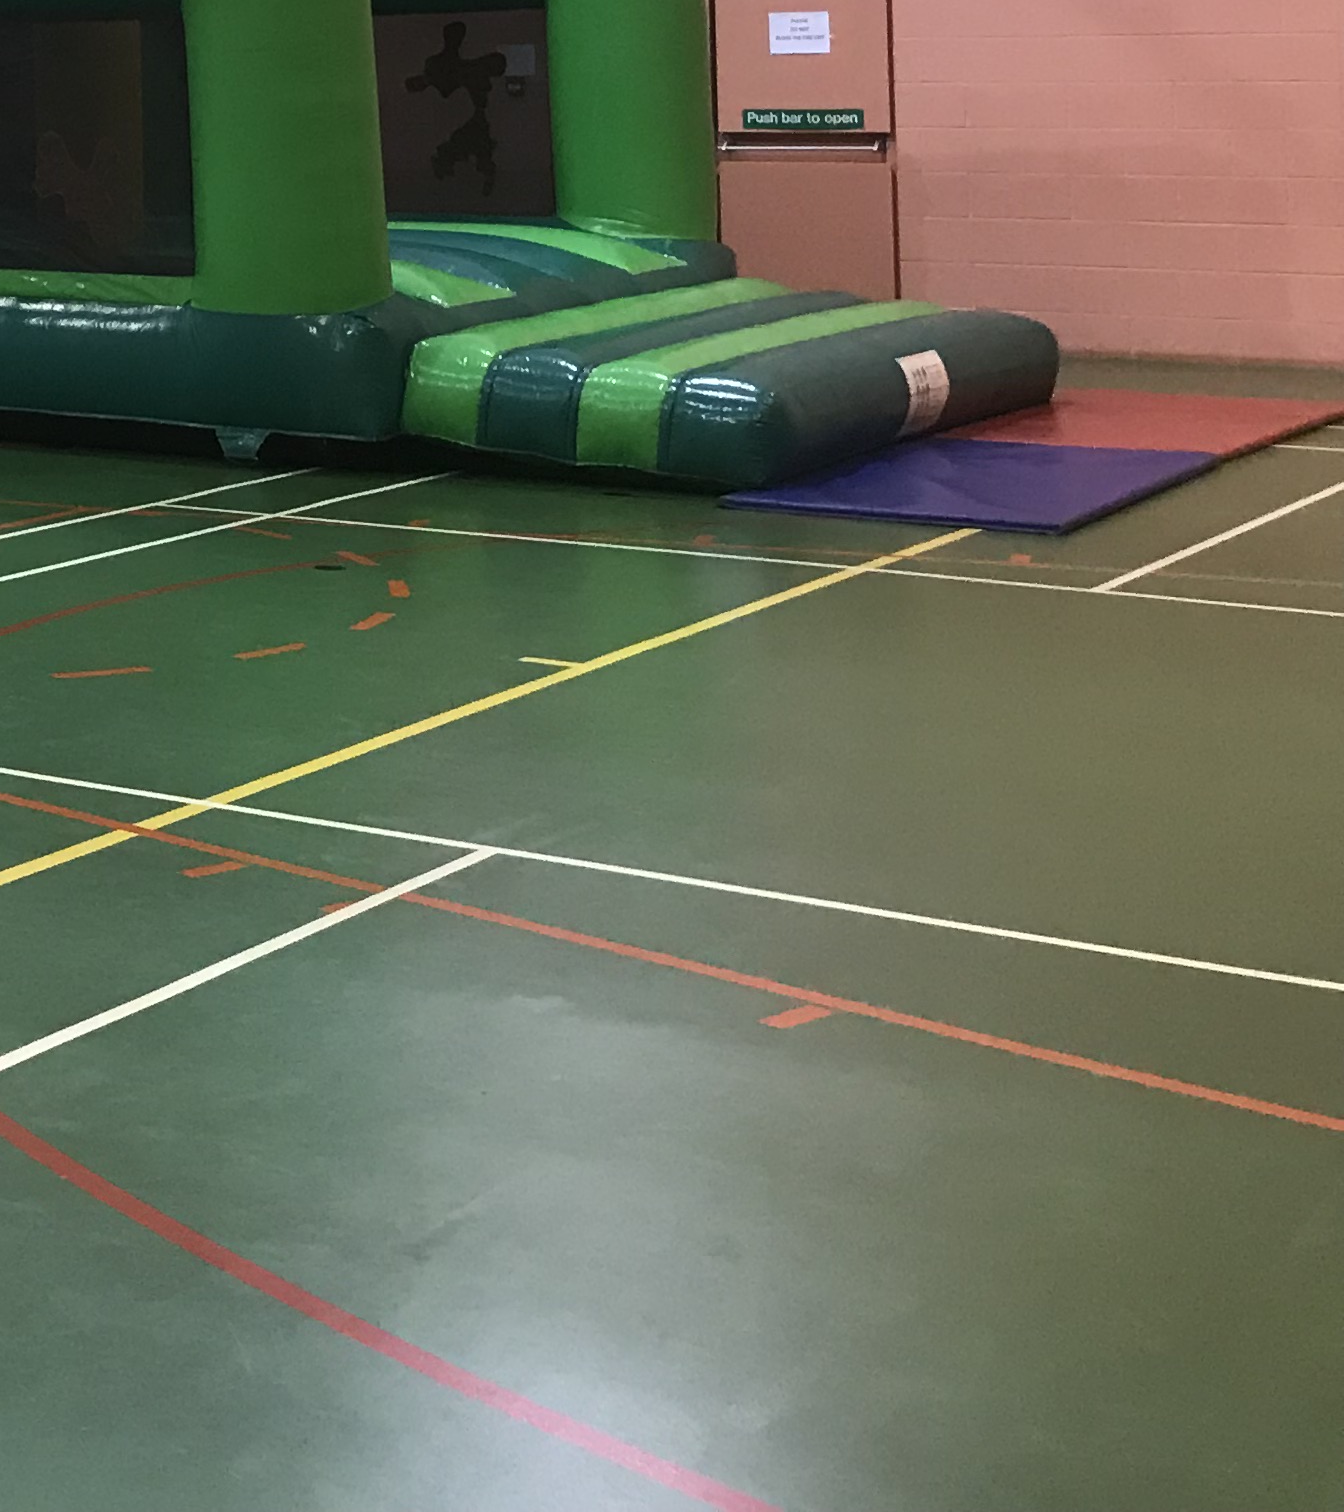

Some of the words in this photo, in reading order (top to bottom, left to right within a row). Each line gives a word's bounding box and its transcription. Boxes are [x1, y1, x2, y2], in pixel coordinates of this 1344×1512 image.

[747, 111, 778, 124] Push
[781, 111, 803, 124] bar
[806, 112, 821, 124] to
[824, 113, 858, 125] open
